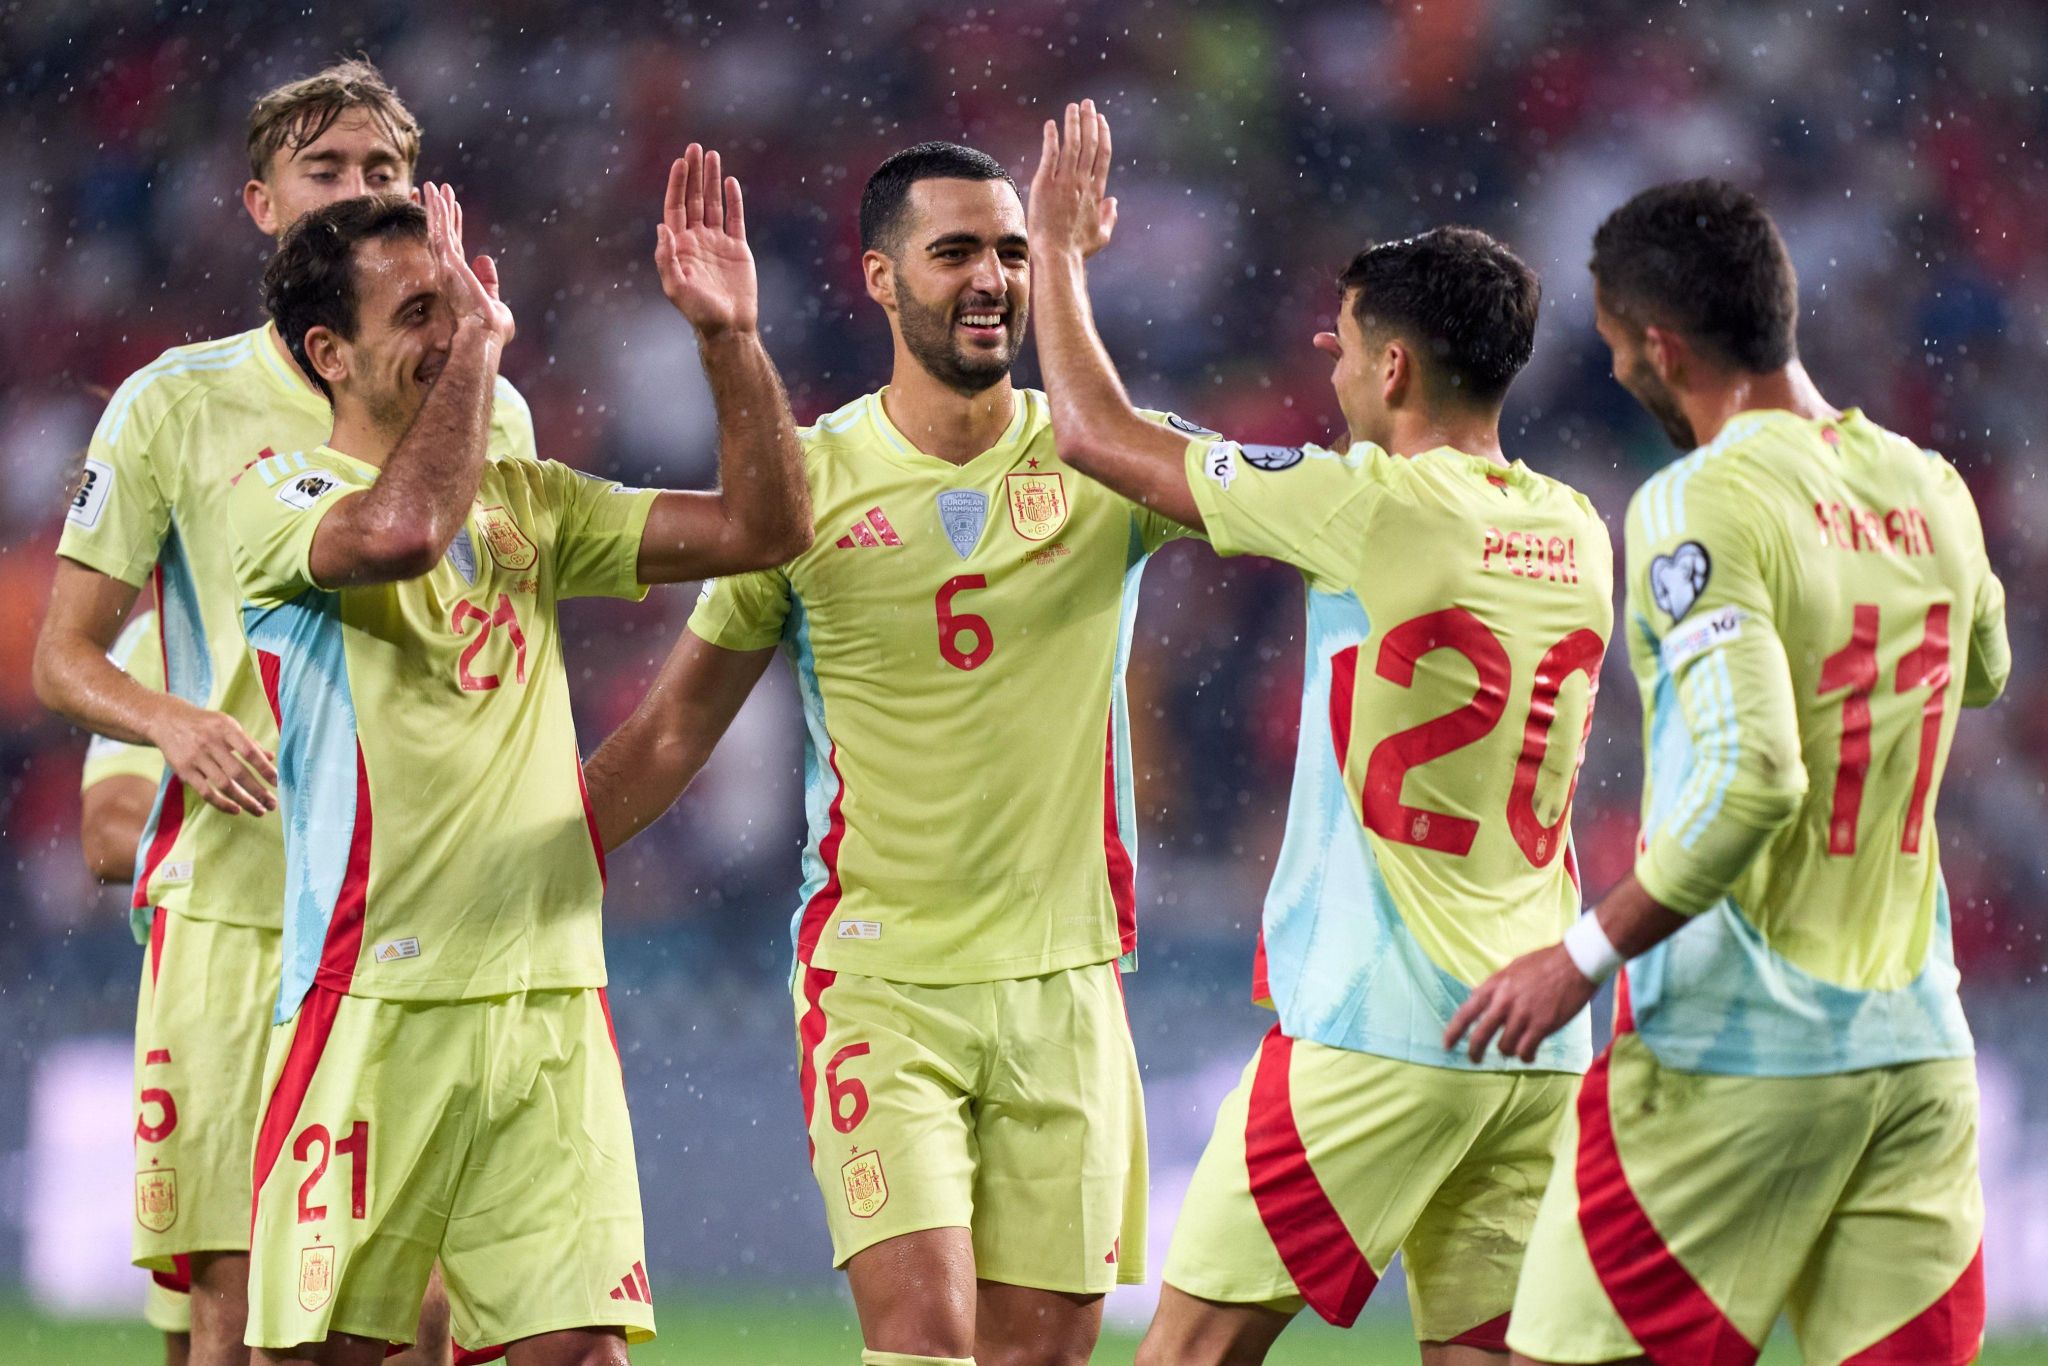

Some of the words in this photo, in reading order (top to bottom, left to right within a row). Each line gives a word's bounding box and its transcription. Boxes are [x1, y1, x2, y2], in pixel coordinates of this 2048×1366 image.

[953, 534, 974, 542] 2024
[1483, 527, 1579, 585] PEDRI
[451, 592, 527, 692] 21
[934, 573, 994, 672] 6
[1362, 606, 1607, 869] 20
[1817, 603, 1952, 857] 11
[135, 1048, 179, 1144] 5
[825, 1041, 871, 1135] 6
[292, 1120, 370, 1225] 21
